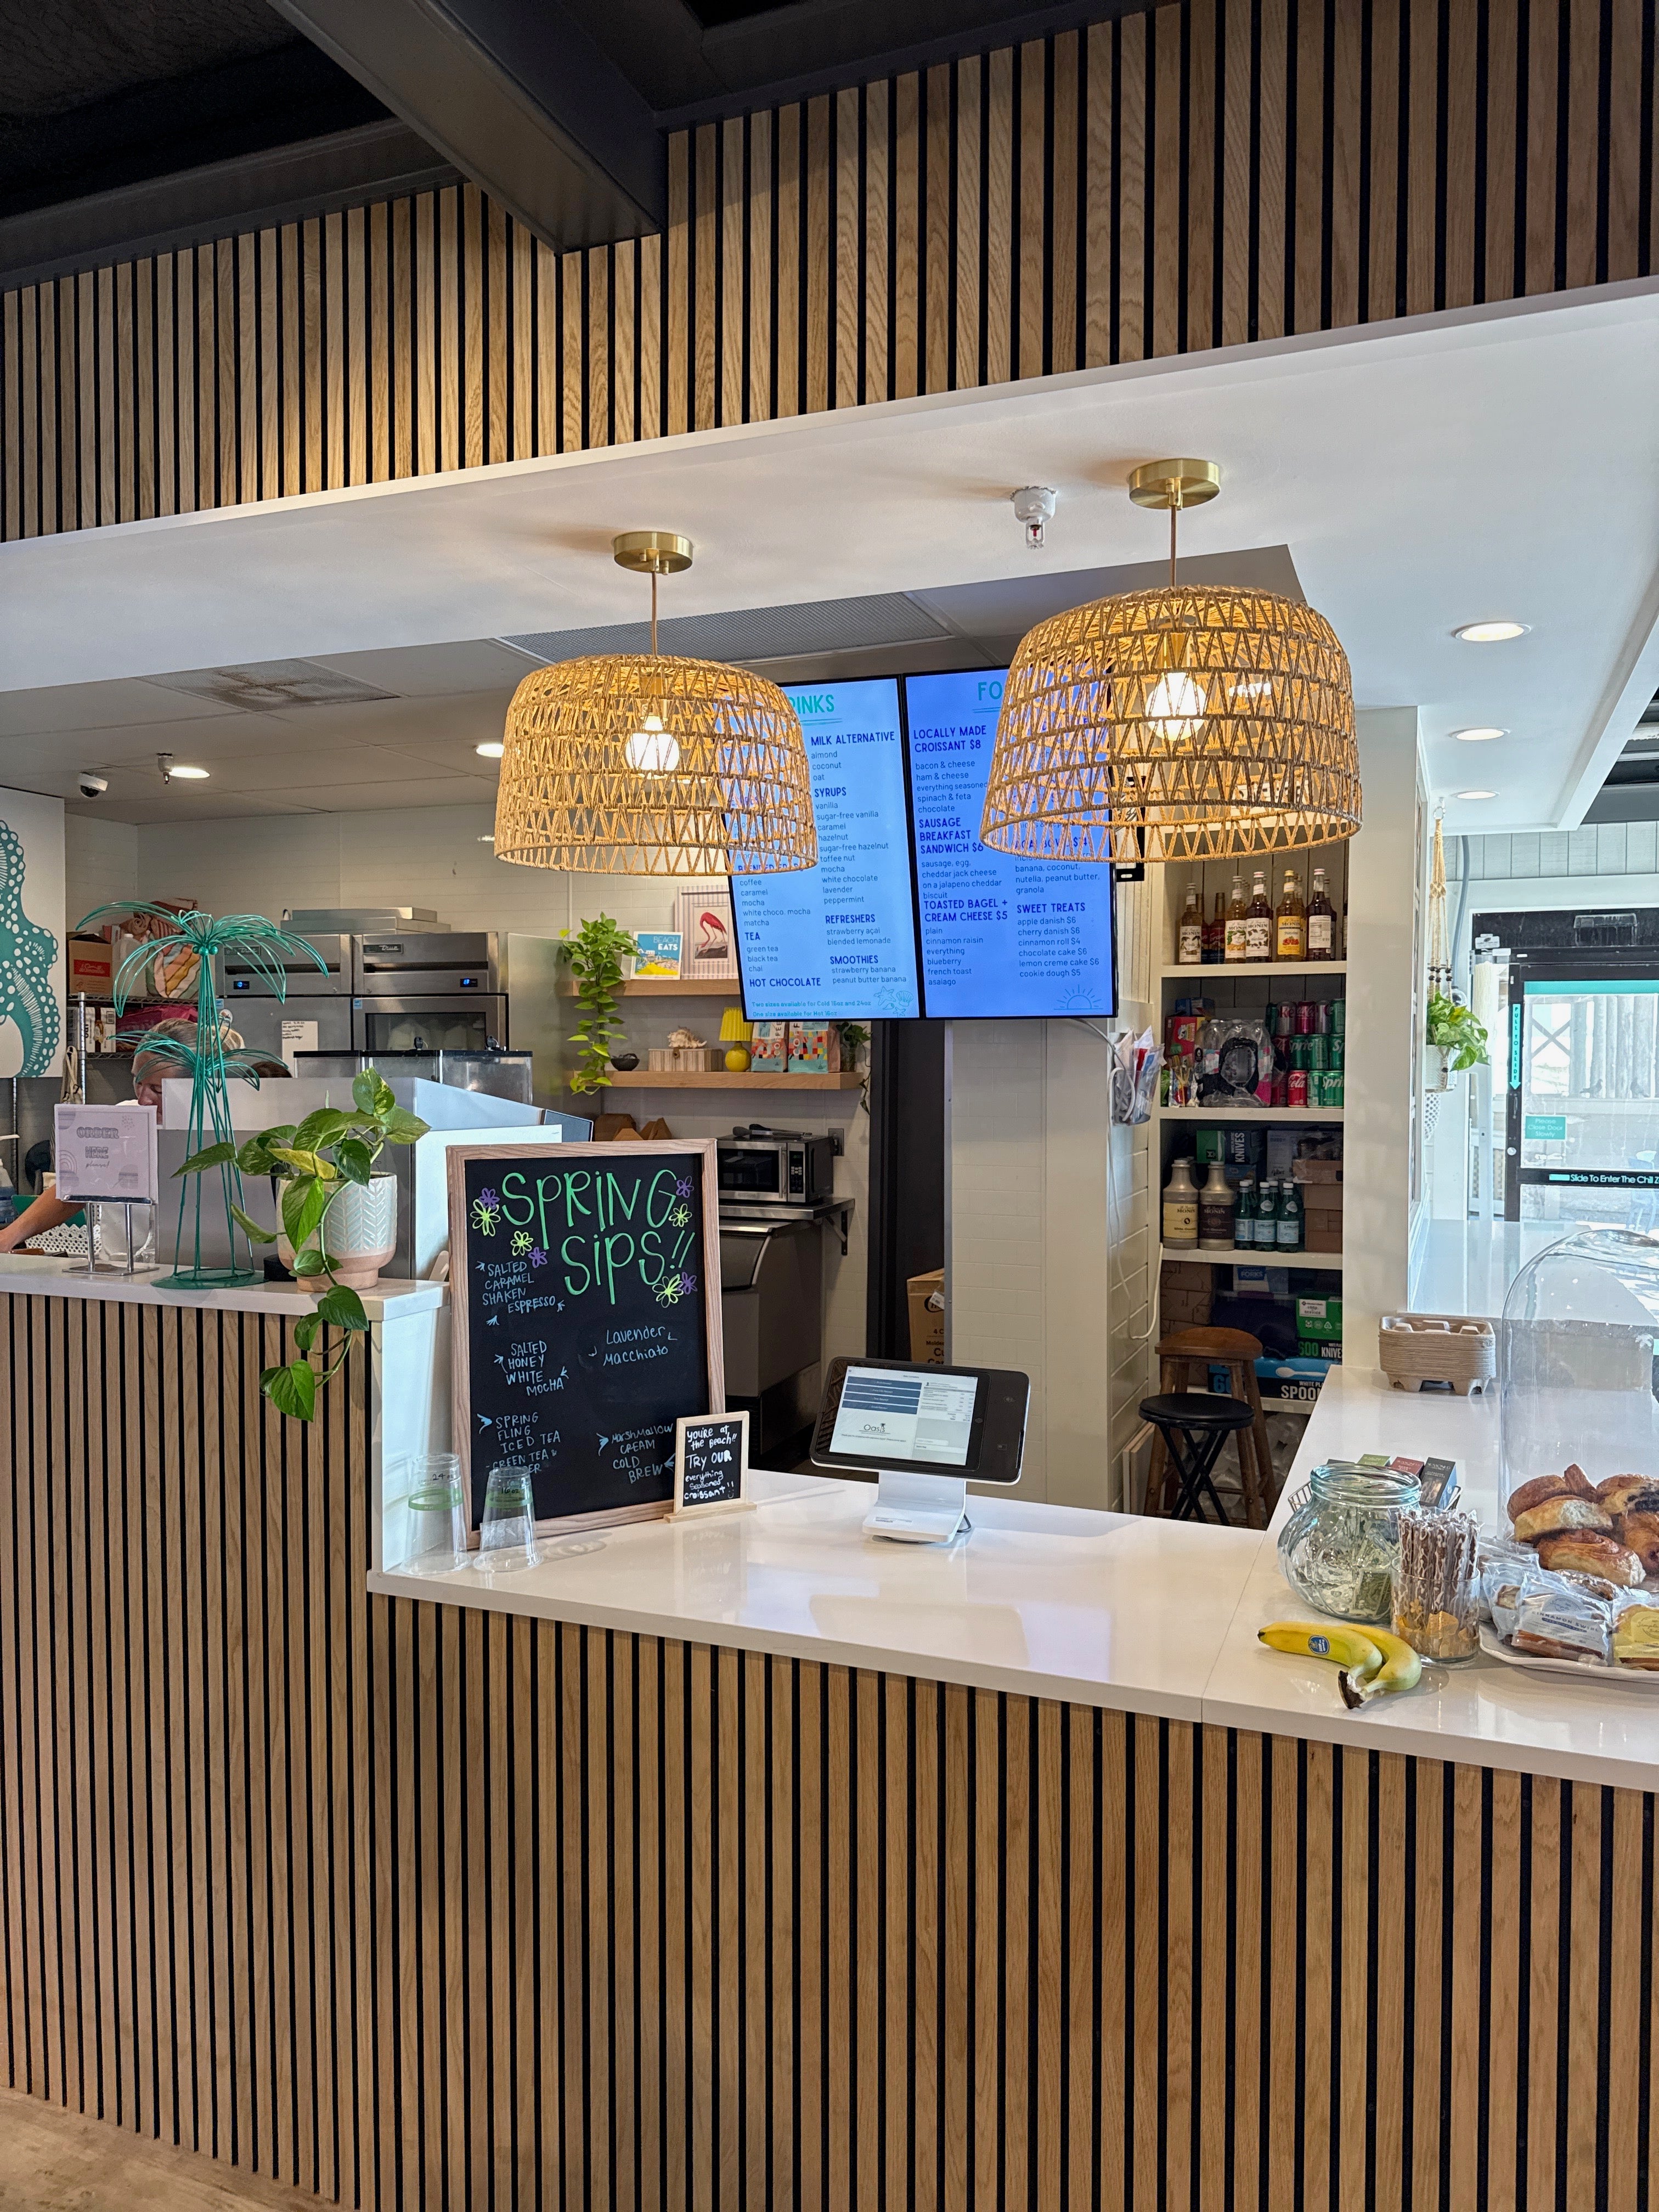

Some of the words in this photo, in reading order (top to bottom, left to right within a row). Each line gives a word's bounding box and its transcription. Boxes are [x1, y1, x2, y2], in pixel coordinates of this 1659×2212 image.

[978, 681, 1002, 700] FO
[789, 695, 834, 714] INKS
[811, 735, 832, 746] MILK
[836, 731, 895, 744] ALTERNATIVE
[913, 727, 956, 740] LOCALLY
[959, 725, 986, 736] MADE
[915, 741, 966, 753] CROISSANT
[970, 739, 981, 750] $8
[811, 750, 838, 759] almond
[812, 761, 842, 770] coconut
[941, 772, 969, 780] cheese
[814, 787, 847, 798] SYRUPS
[917, 783, 953, 792] everything
[917, 794, 947, 804] spinach
[948, 793, 954, 801] &
[815, 802, 838, 810] vanilla
[918, 805, 955, 813] chocolate
[816, 811, 854, 822] sugar-free
[855, 810, 879, 819] vanilla
[817, 822, 846, 831] caramel
[919, 817, 961, 828] SAUSAGE
[818, 833, 849, 842] hazelnut
[919, 830, 971, 842] BREAKFAST
[819, 843, 857, 854] sugar-free
[858, 842, 889, 850] hazelnut
[921, 843, 969, 854] SANDWICH
[972, 842, 984, 853] $6
[843, 874, 878, 883] chocolate
[822, 885, 853, 894] lavender
[1015, 885, 1045, 895] granola
[823, 896, 865, 905] peppermint
[923, 899, 964, 910] TOASTED
[968, 898, 998, 909] BAGEL
[1017, 904, 1047, 914] SWEET
[1051, 902, 1085, 912] TREATS
[825, 913, 876, 924] REFRESHERS
[924, 912, 957, 922] CREAM
[960, 911, 993, 921] CHEESE
[996, 910, 1008, 921] $5
[1017, 918, 1039, 927] apple
[1040, 917, 1065, 925] danish
[1066, 916, 1076, 924] $6
[744, 932, 760, 941] TEA
[826, 928, 865, 936] strawberry
[1018, 928, 1042, 937] cherry
[1043, 927, 1069, 935] danish
[1070, 926, 1080, 935] $6
[827, 938, 855, 946] blended
[856, 936, 891, 945] lemonade
[1071, 937, 1081, 945] $4
[1018, 949, 1056, 957] chocolate
[1077, 947, 1087, 956] $6
[830, 955, 878, 965] SMOOTHIES
[1090, 957, 1099, 966] $6
[831, 966, 869, 975] strawberry
[1046, 969, 1070, 978] dough
[1071, 968, 1081, 977] $5
[749, 978, 766, 988] HOT
[769, 977, 821, 987] CHOCOLATE
[832, 977, 856, 985] peanut
[1514, 1035, 1518, 1045] TO
[77, 1127, 119, 1139] ORDER
[86, 1146, 109, 1159] HERE
[1235, 1132, 1245, 1163] KNIVES
[488, 1261, 527, 1277] SALTED
[485, 1272, 534, 1291] CARAMEL
[482, 1288, 526, 1305] SHAKEN
[508, 1296, 556, 1314] ESPRESSO
[606, 1325, 665, 1344] Lavender
[511, 1340, 546, 1357] SALTED
[507, 1354, 544, 1369] HONEY
[603, 1345, 668, 1366] Macchiato
[506, 1370, 543, 1385] WHITE
[527, 1378, 564, 1396] MOCHA
[1281, 1385, 1321, 1400] SPOO
[496, 1412, 539, 1429] SPRING
[498, 1425, 531, 1441] FLING
[500, 1436, 534, 1454] ICED
[540, 1430, 560, 1444] TEA
[620, 1440, 655, 1454] CREAM
[691, 1439, 704, 1451] the
[493, 1455, 526, 1468] GREEN
[529, 1449, 549, 1462] TEA
[613, 1456, 640, 1469] COLD
[712, 1449, 732, 1464] OUR
[628, 1464, 663, 1483] BREW
[685, 1470, 724, 1482] everything
